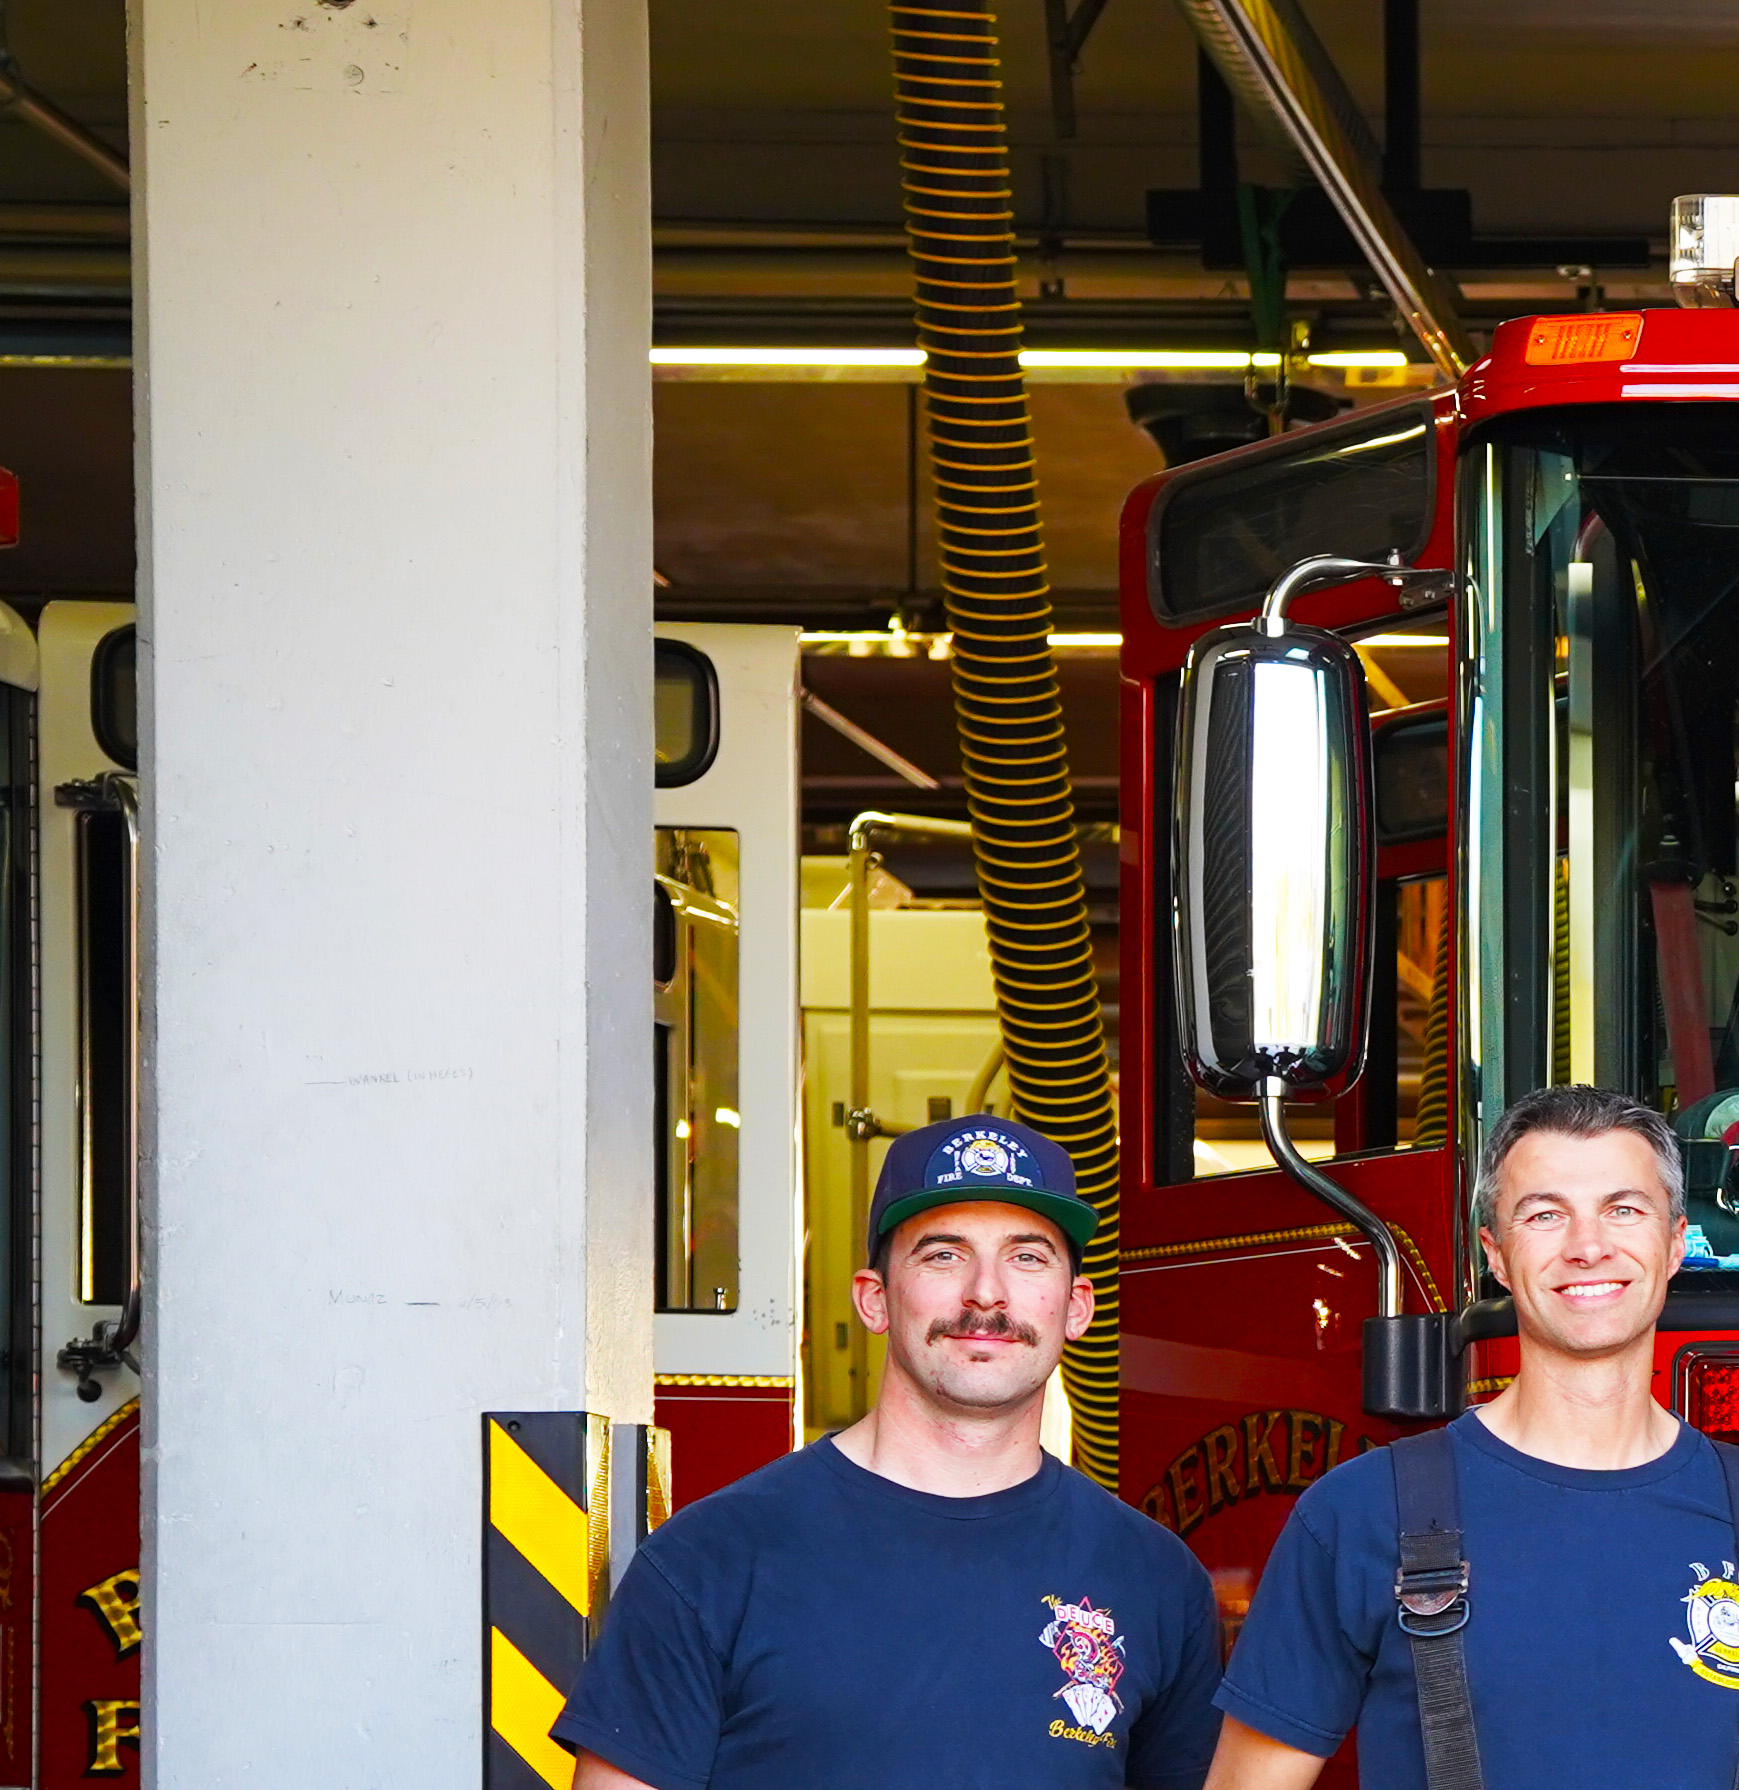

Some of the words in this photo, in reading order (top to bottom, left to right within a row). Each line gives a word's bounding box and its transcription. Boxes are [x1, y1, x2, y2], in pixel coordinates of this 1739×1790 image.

[942, 1130, 1029, 1159] BERKELEY
[937, 1171, 963, 1185] FIRE
[1056, 1605, 1113, 1633] DEUCE
